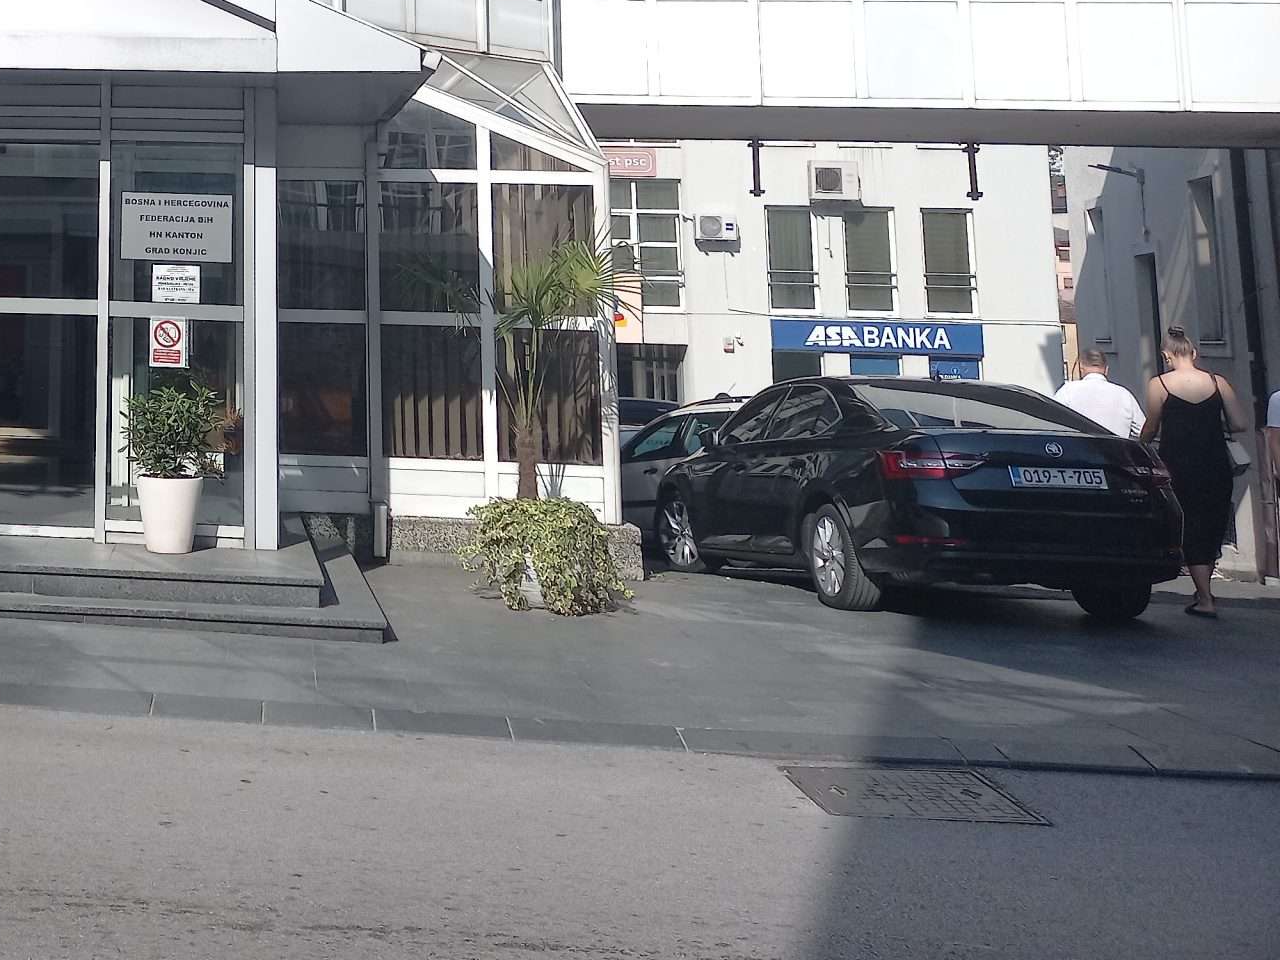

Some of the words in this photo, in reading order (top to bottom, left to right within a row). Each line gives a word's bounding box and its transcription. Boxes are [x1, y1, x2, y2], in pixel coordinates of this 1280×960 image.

[609, 157, 621, 166] st
[624, 158, 647, 168] psc
[124, 198, 156, 206] BOSNA
[164, 199, 230, 208] HERCEGOVINA
[139, 214, 196, 223] FEDERACIJA
[165, 231, 203, 239] KANTON
[144, 246, 170, 254] GRAD
[172, 247, 207, 255] KONJIC
[804, 325, 864, 347] ASA
[863, 326, 952, 350] BANKA
[1023, 468, 1103, 485] 019-T-705
